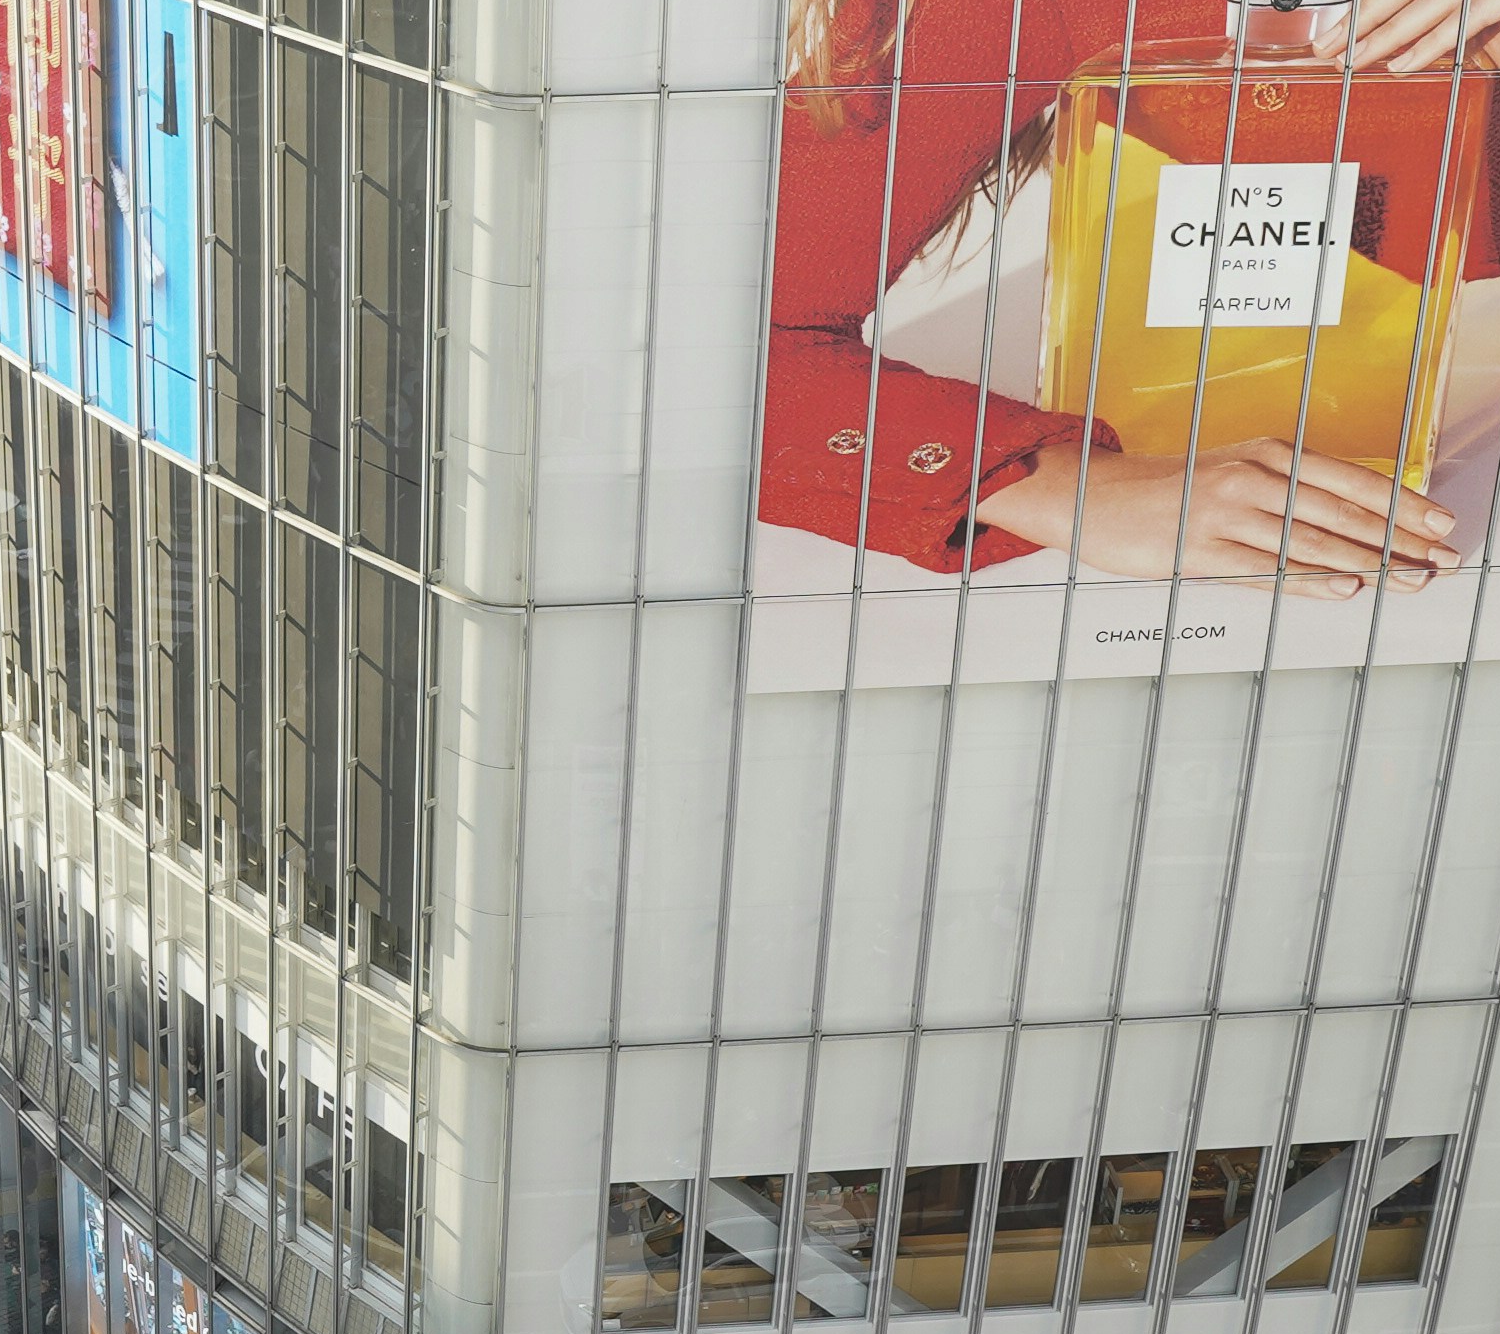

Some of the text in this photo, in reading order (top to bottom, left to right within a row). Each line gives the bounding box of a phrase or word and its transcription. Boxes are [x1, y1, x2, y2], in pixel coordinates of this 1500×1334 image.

[1230, 186, 1284, 208] N°5
[1222, 257, 1277, 272] PARIS
[1095, 624, 1227, 645] CHANE.COM
